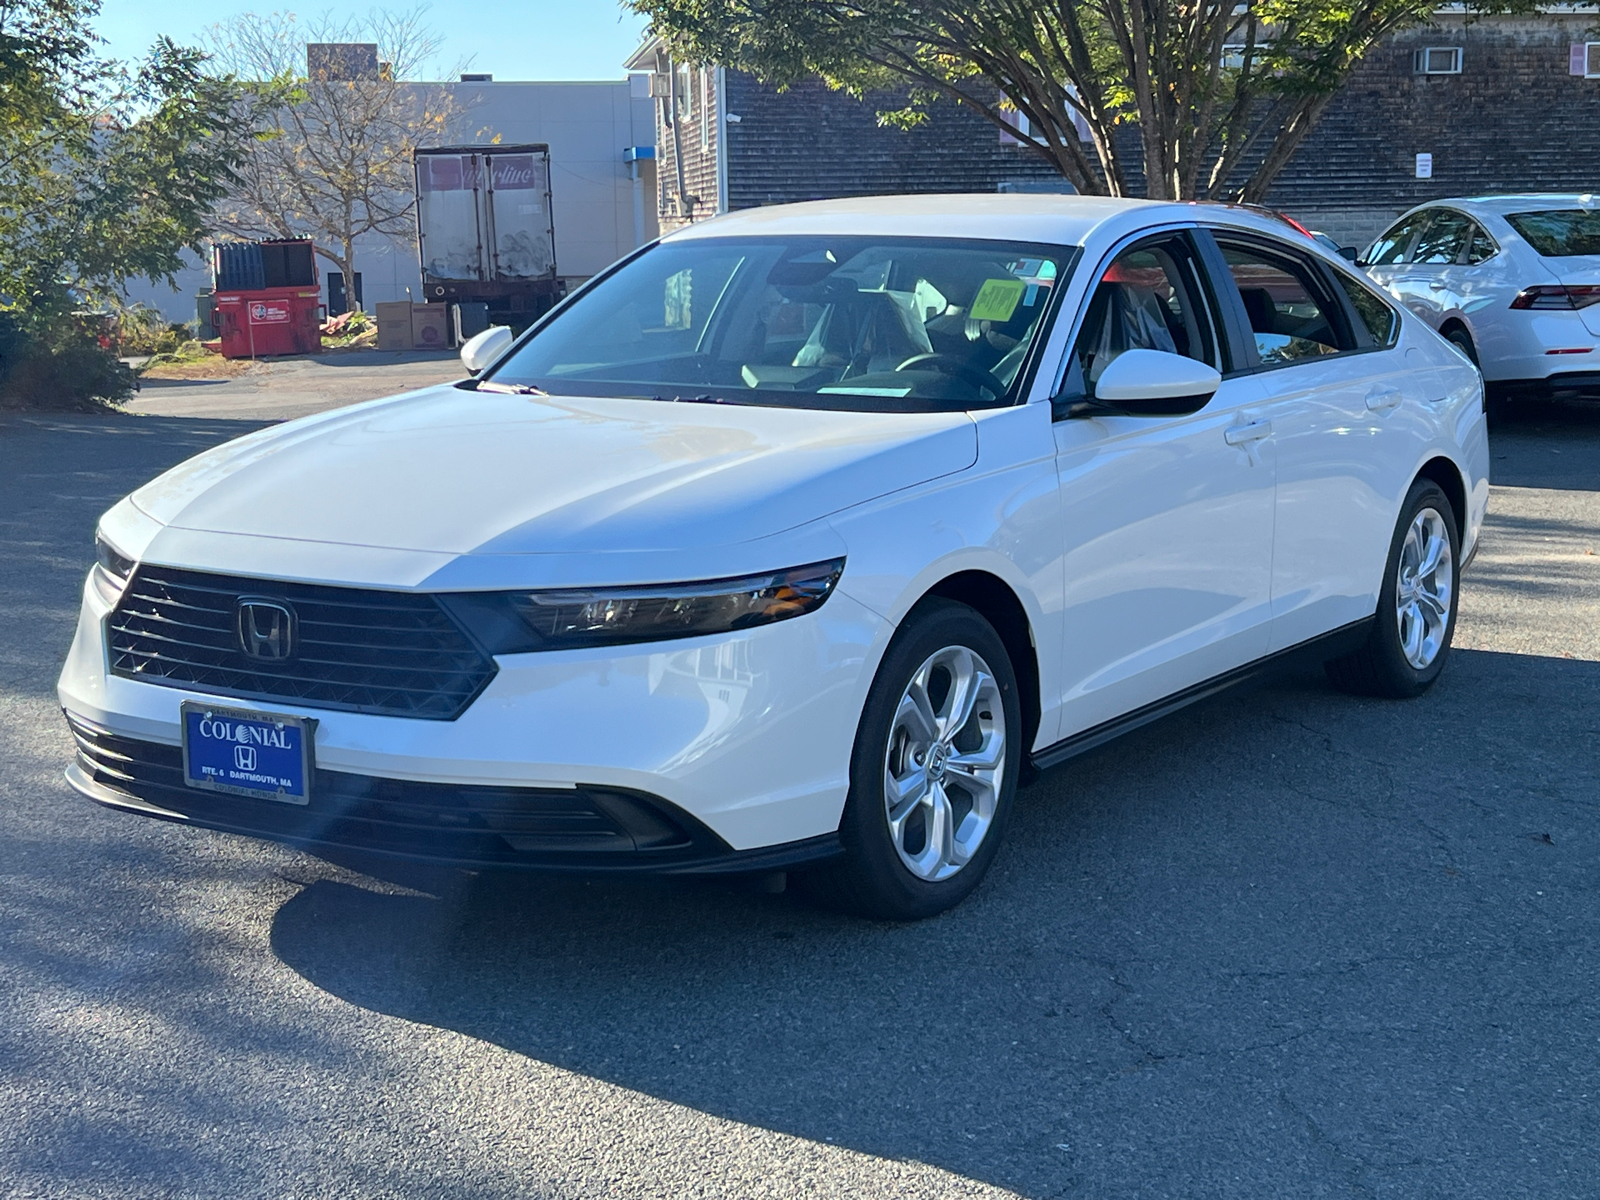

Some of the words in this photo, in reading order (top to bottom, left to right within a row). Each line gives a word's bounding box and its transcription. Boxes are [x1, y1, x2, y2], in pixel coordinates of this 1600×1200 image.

[200, 719, 292, 749] COLONIAL
[201, 766, 218, 776] RTE.
[219, 769, 225, 777] 6
[229, 770, 279, 786] DARTMOUTH,
[280, 778, 292, 787] MA
[214, 784, 250, 796] COLONIAL
[251, 789, 278, 800] HONDA
